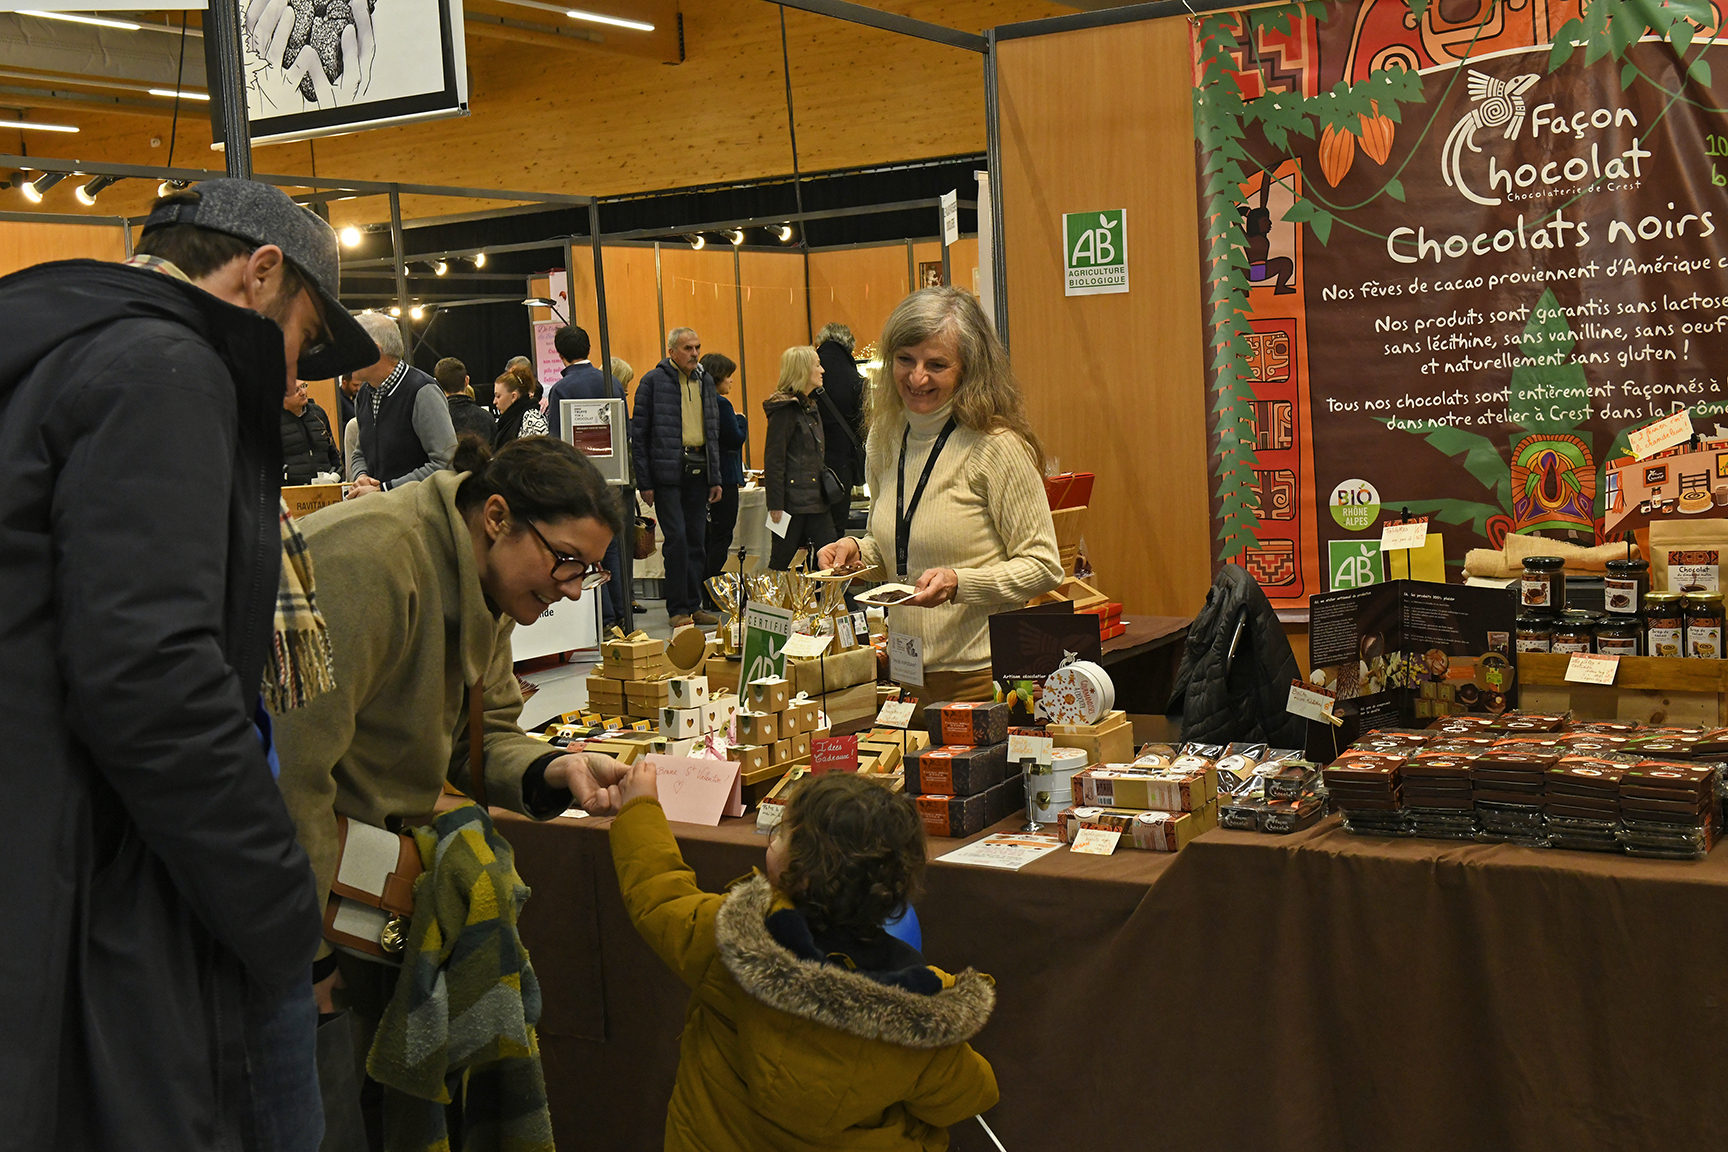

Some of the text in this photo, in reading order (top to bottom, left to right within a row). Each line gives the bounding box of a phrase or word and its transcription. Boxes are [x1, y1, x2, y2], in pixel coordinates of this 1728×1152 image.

[1532, 103, 1638, 139] Façon
[1442, 136, 1652, 206] Chocolat
[1507, 180, 1642, 202] Chocolaterie de Crest
[1072, 228, 1115, 266] AB
[1387, 202, 1715, 264] Chocolats noirs
[1069, 266, 1125, 277] AGRICULTURE
[1069, 276, 1126, 286] BIOLOGIQUE
[1321, 284, 1355, 301] Nos
[1360, 280, 1403, 298] fèves
[1408, 276, 1428, 294] de
[1434, 276, 1484, 292] cacao
[1488, 260, 1600, 290] proviennent
[1606, 254, 1711, 278] d'Amérique
[1374, 315, 1409, 333] Nos
[1414, 308, 1484, 333] produits
[1490, 303, 1530, 324] sont
[1536, 298, 1610, 324] garantis
[1617, 300, 1657, 315] sans
[1384, 341, 1421, 355] sans
[1427, 332, 1497, 350] lécithine,
[1503, 331, 1543, 346] sans
[1549, 322, 1628, 342] vanilline,
[1634, 323, 1674, 338] sans
[1420, 339, 1690, 375] et naturellement sans gluten !
[1326, 397, 1359, 413] Tous
[1364, 398, 1391, 411] nos
[1396, 389, 1469, 409] chocolats
[1474, 386, 1512, 404] sont
[1518, 380, 1616, 400] entièrement
[1621, 377, 1704, 400] façonnés
[1710, 378, 1721, 392] à
[1386, 415, 1423, 431] dans
[1428, 411, 1472, 429] notre
[1477, 409, 1529, 425] atelier
[1535, 406, 1545, 422] à
[1550, 404, 1594, 421] Crest
[1600, 403, 1643, 420] dans
[1649, 402, 1665, 417] la
[1342, 506, 1368, 516] RHÔNE
[1334, 556, 1375, 588] AB
[748, 615, 788, 635] CERTIFIÉ
[816, 739, 842, 752] Idées
